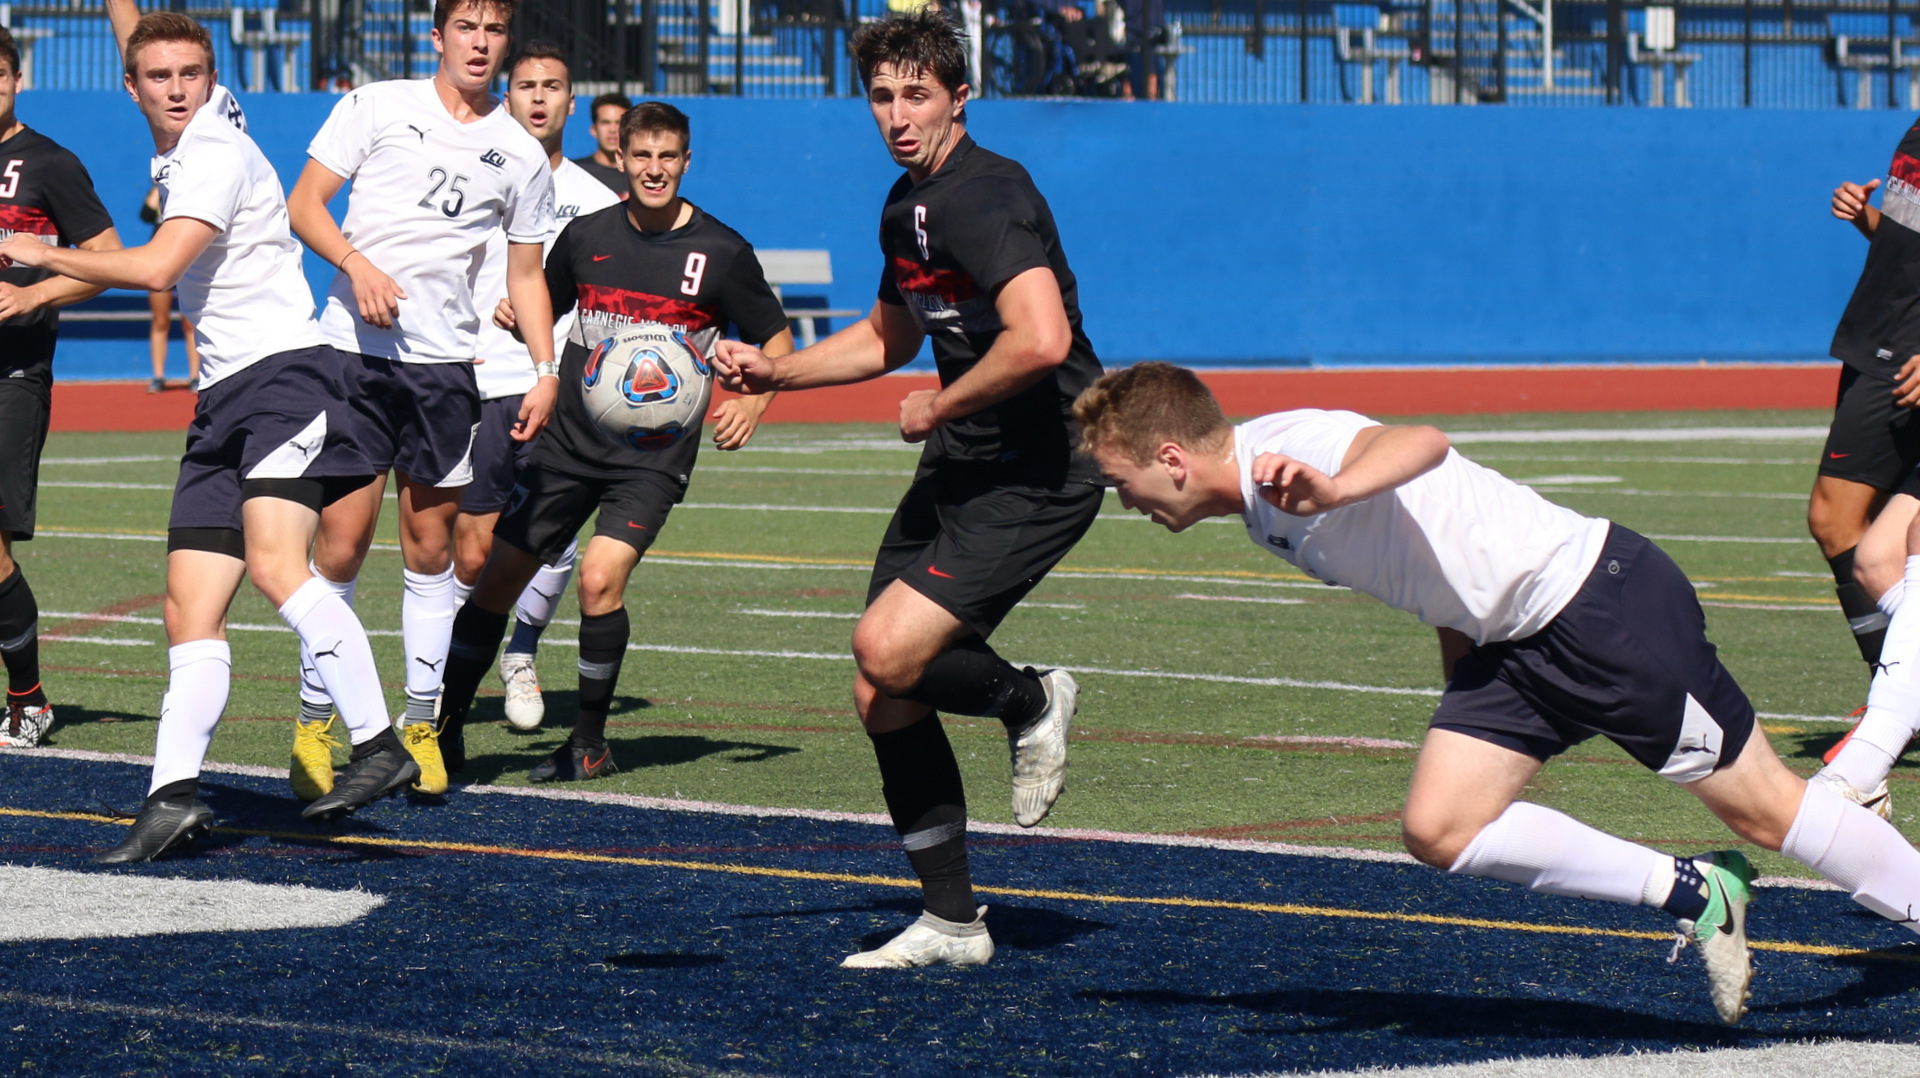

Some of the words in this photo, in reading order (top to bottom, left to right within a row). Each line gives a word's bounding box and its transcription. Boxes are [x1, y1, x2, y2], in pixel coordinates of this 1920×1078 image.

[480, 148, 507, 168] JCU
[0, 159, 24, 199] 5
[417, 165, 470, 218] 25
[556, 204, 581, 219] JCU
[913, 204, 929, 261] 6
[680, 251, 708, 297] 9
[623, 333, 668, 344] Wilson
[1052, 710, 1066, 753] adidas
